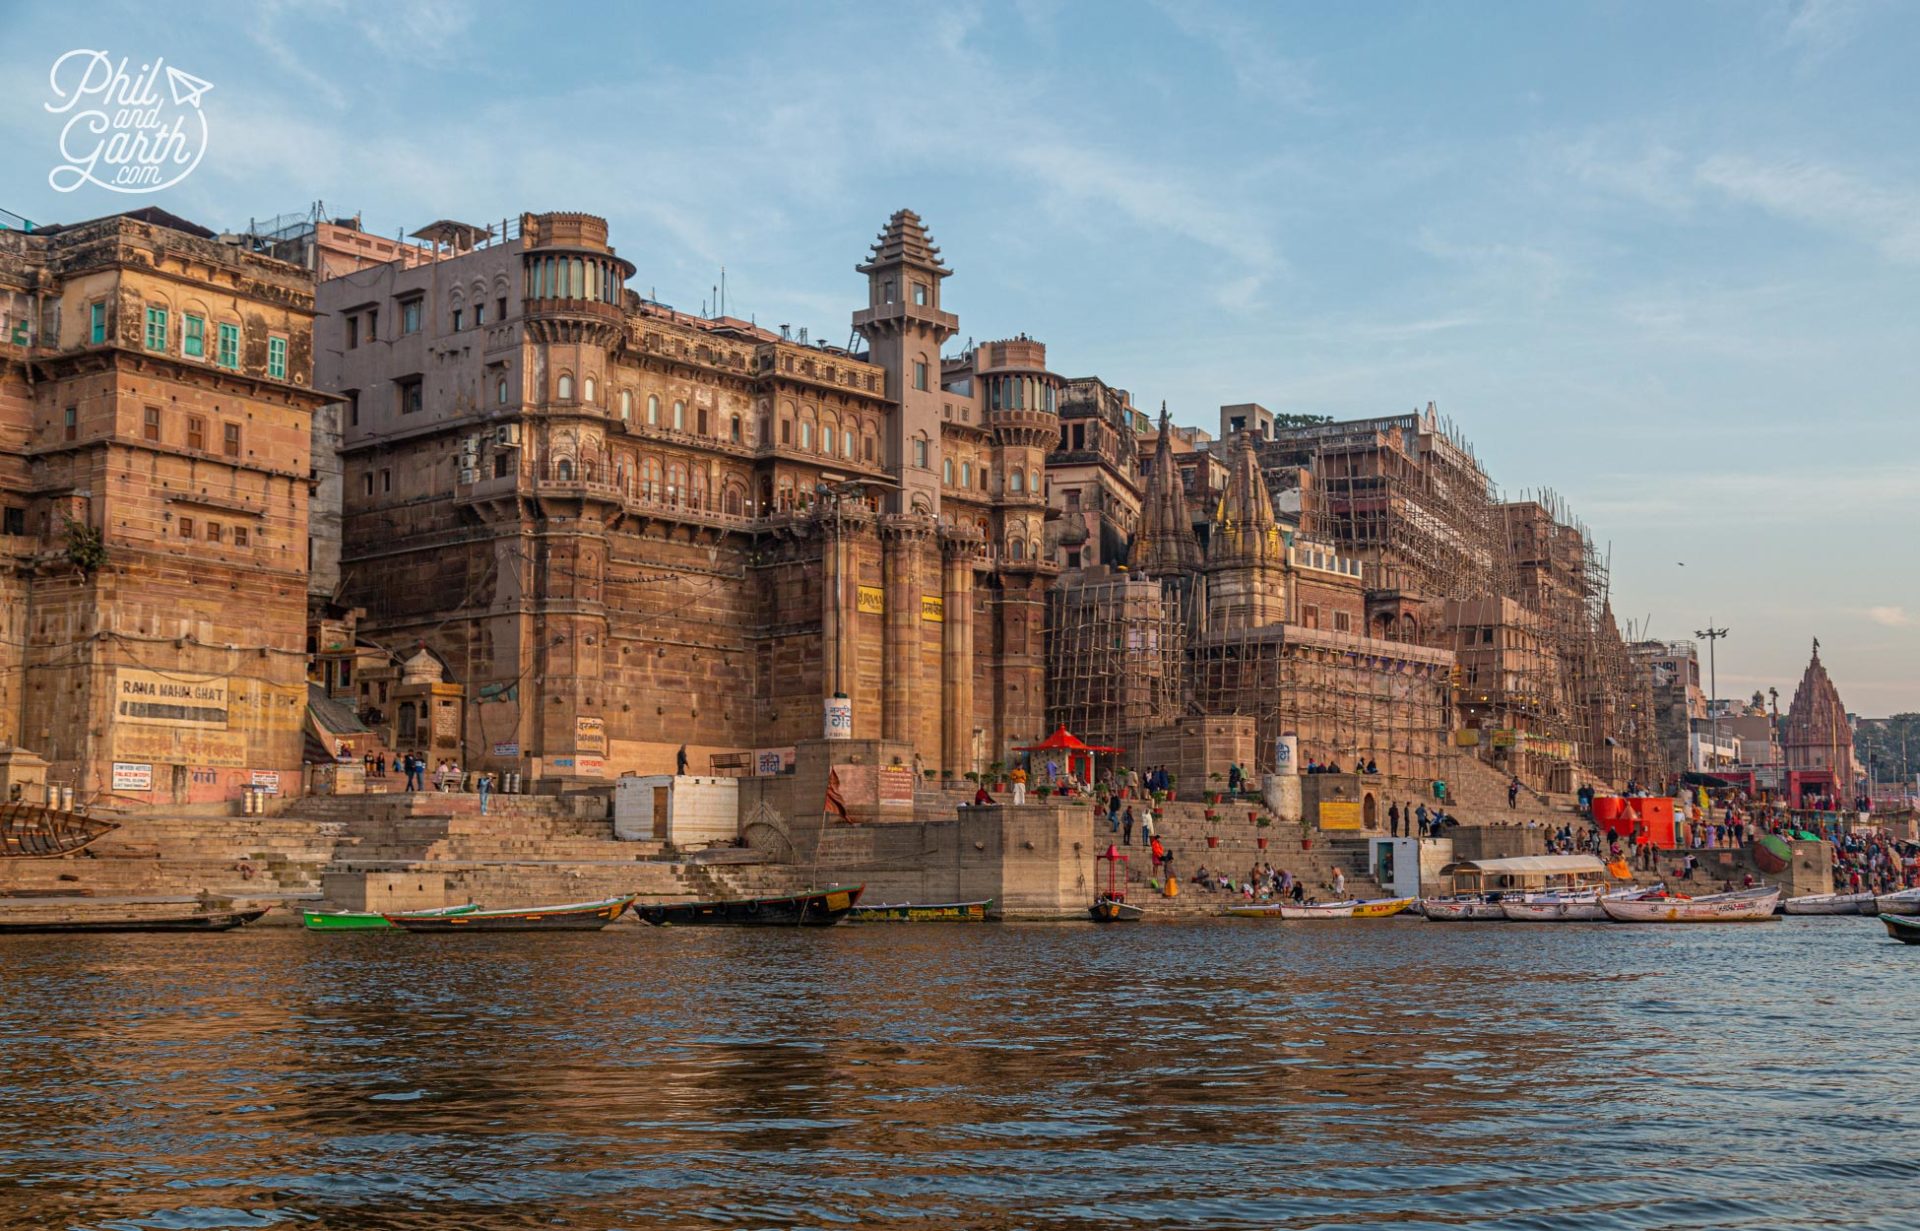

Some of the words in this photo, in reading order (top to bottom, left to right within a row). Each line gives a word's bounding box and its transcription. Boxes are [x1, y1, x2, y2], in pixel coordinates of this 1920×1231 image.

[123, 681, 156, 696] RANA
[159, 684, 192, 698] MAHAL
[195, 687, 223, 701] GHAT
